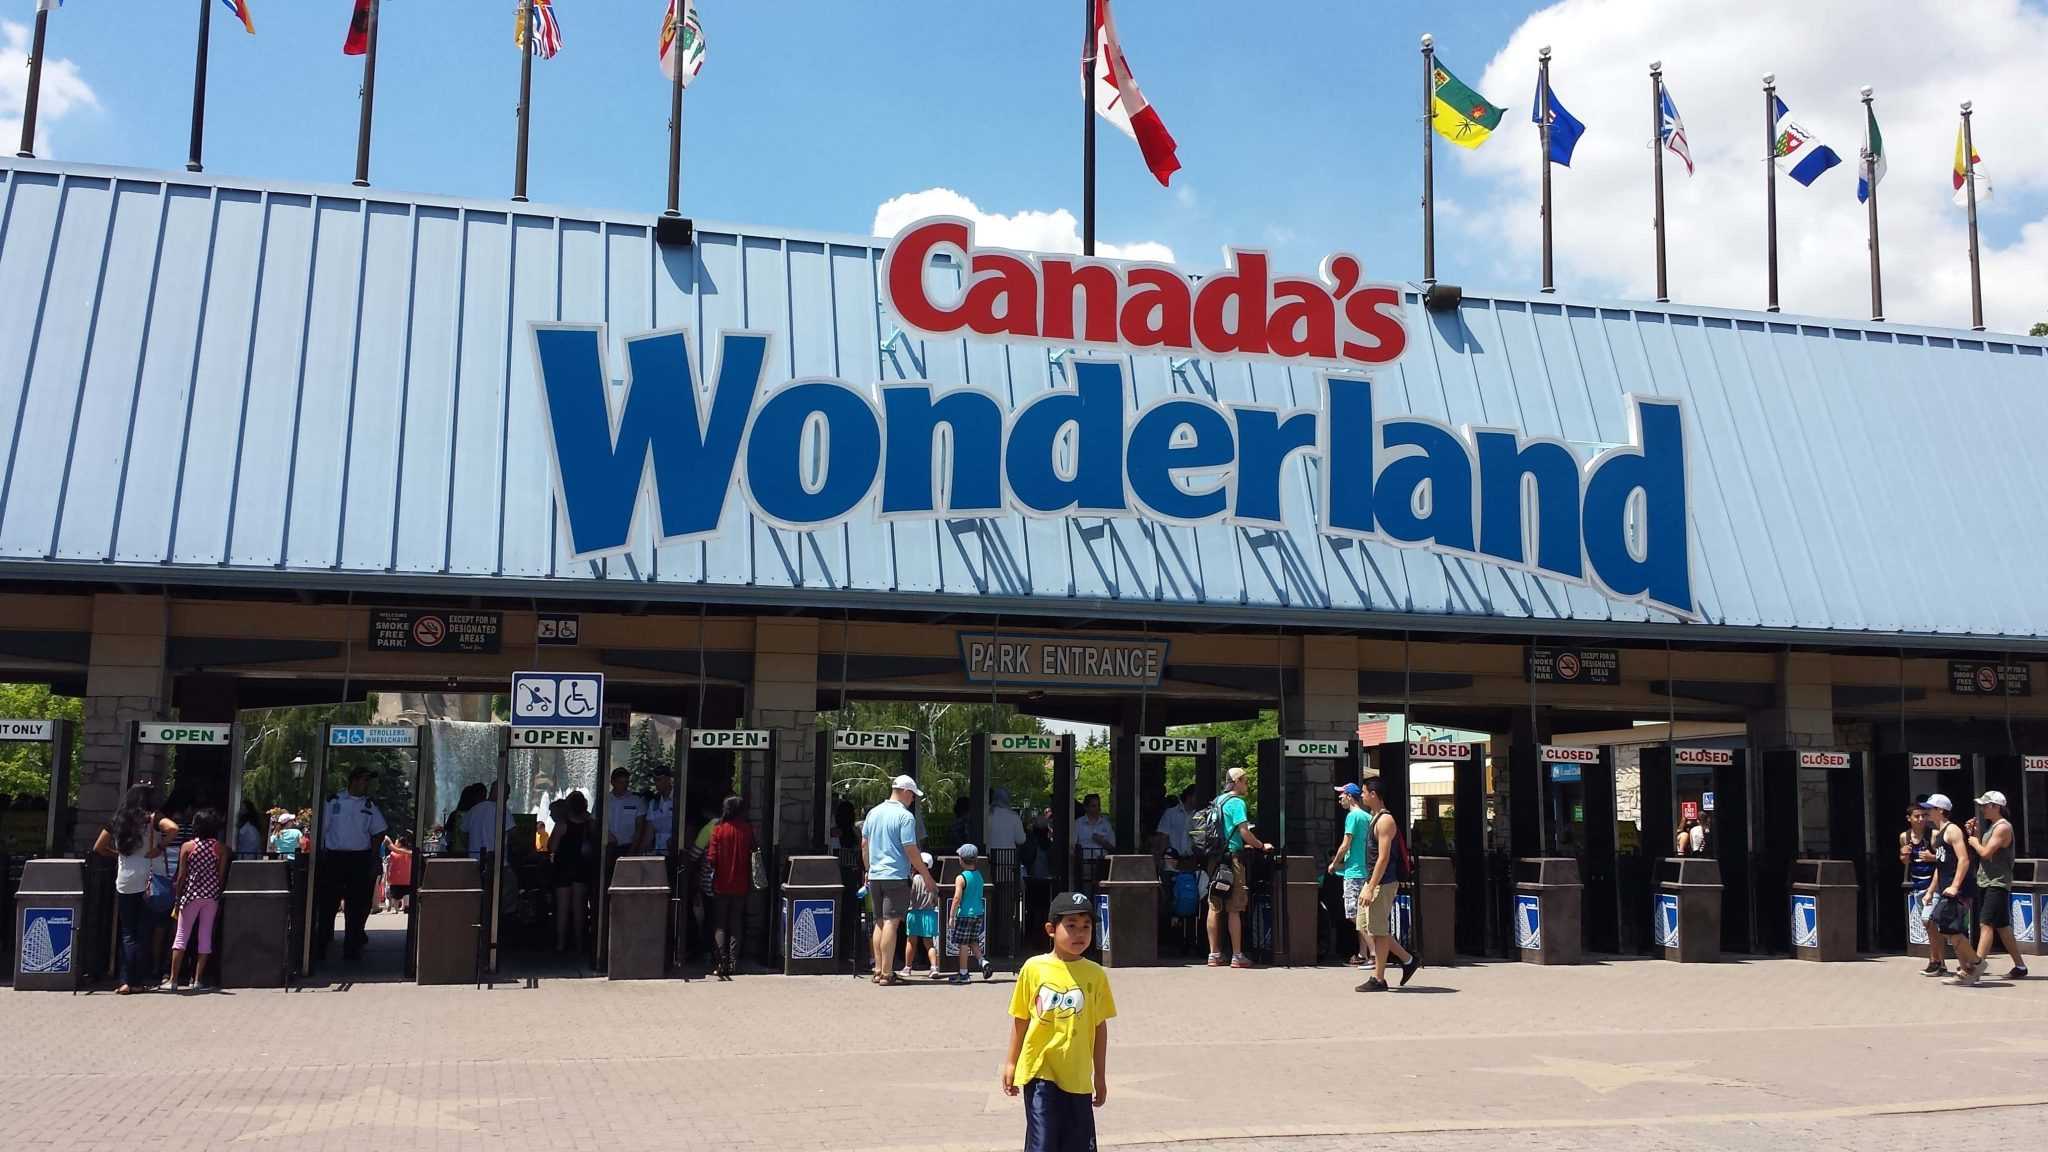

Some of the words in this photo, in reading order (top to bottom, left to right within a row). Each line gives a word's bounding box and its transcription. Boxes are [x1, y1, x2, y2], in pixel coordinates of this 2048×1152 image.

[889, 222, 1407, 363] Canada's
[535, 329, 1693, 612] Wonderland
[449, 615, 475, 624] EXCEPT
[476, 615, 489, 624] FOR
[490, 616, 497, 625] IN
[375, 622, 409, 631] SMOKE
[449, 624, 497, 634] DESIGNATED
[379, 630, 405, 639] FREE
[459, 634, 486, 643] AREAS
[377, 638, 407, 648] PARK!
[970, 643, 1032, 674] PARK
[1042, 645, 1158, 677] ENTRANCE
[12, 724, 43, 735] ONLY
[160, 728, 215, 742] OPEN
[524, 729, 584, 745] OPEN
[702, 732, 759, 746] OPEN
[845, 732, 899, 748] OPEN
[1002, 737, 1051, 749] OPEN
[1148, 738, 1198, 752] OPEN
[1298, 743, 1338, 754] OPEN
[1409, 743, 1468, 757] CLOSED
[1546, 749, 1594, 761] CLOSED
[1679, 751, 1729, 763] CLOSED
[1801, 754, 1844, 766] CLOSED
[1912, 757, 1958, 767] CLOSED
